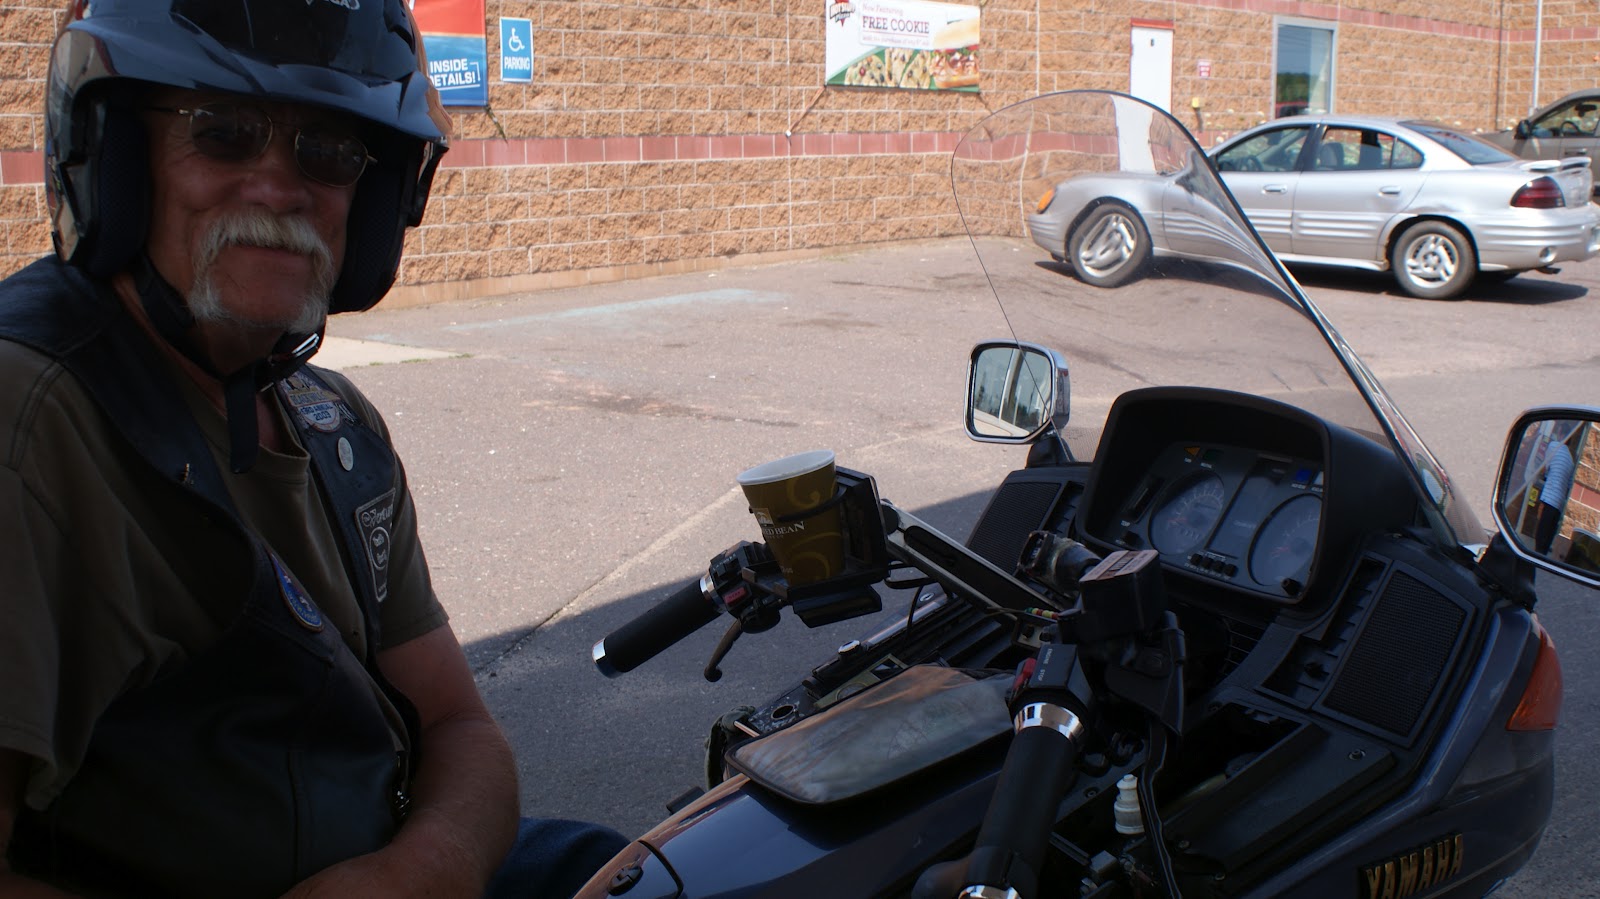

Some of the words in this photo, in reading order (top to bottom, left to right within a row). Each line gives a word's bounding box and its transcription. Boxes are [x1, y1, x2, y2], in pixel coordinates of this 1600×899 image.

[862, 16, 888, 30] FREE
[890, 18, 930, 34] COOKIE
[430, 58, 468, 74] INSIDE
[504, 56, 530, 70] PARKING
[774, 520, 805, 535] BEAN
[1365, 833, 1463, 899] YAMAHA
